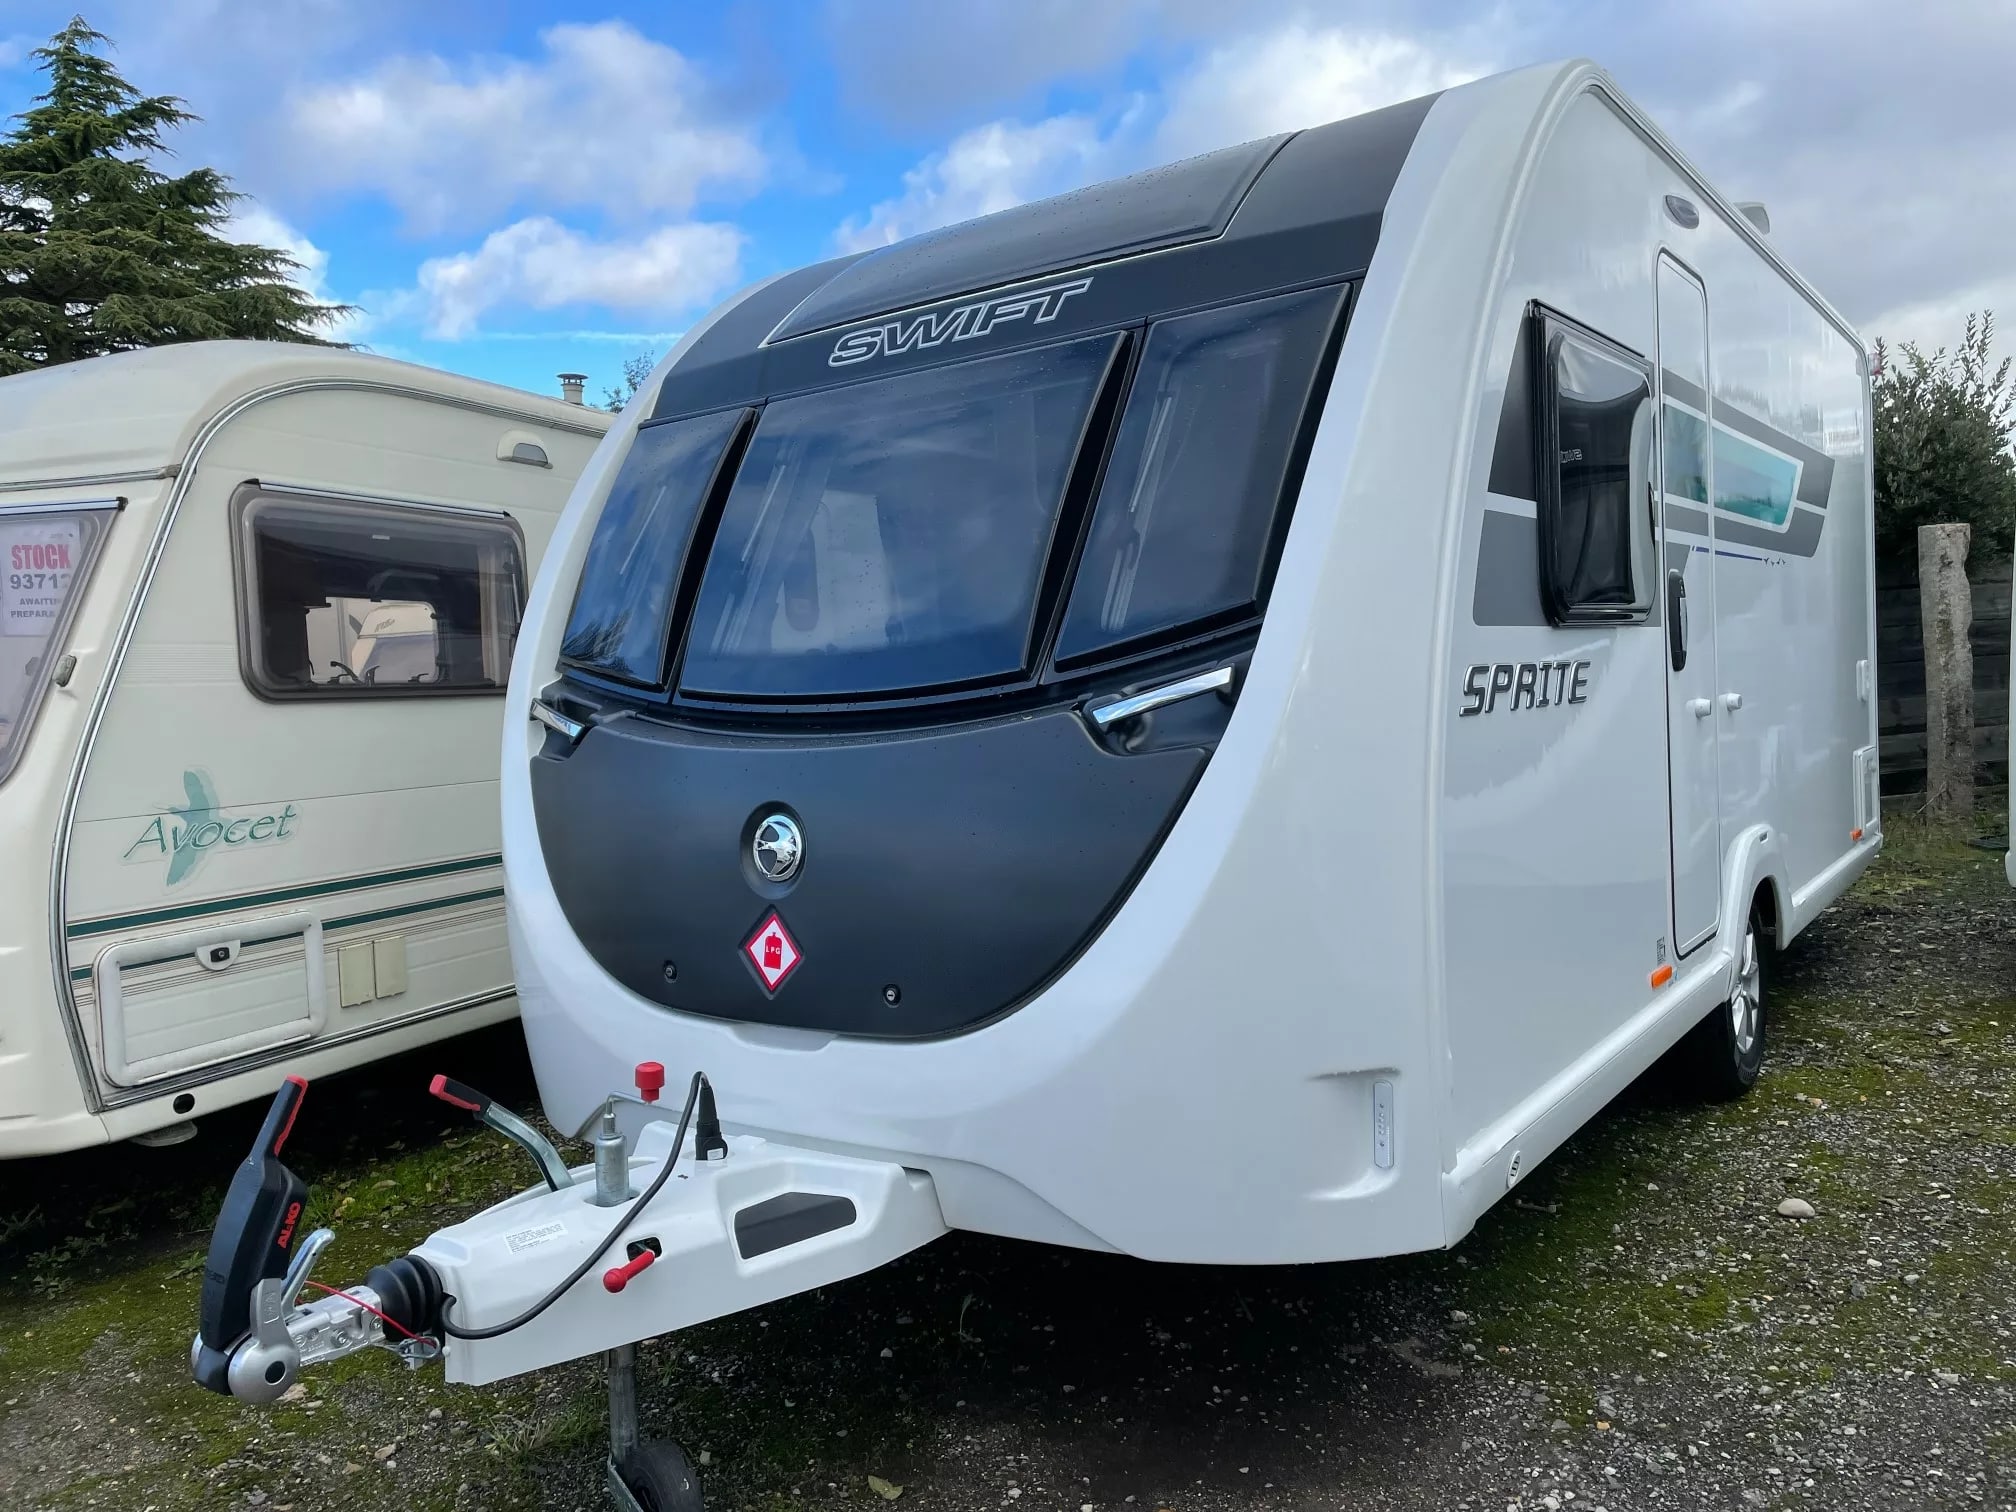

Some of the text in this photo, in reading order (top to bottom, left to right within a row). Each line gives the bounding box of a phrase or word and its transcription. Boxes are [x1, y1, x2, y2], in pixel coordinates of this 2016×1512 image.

[828, 277, 1094, 367] SWIFT
[11, 544, 71, 570] STOCK
[1459, 661, 1591, 717] SPRITE
[123, 804, 297, 858] Avocet
[765, 945, 781, 955] LPG
